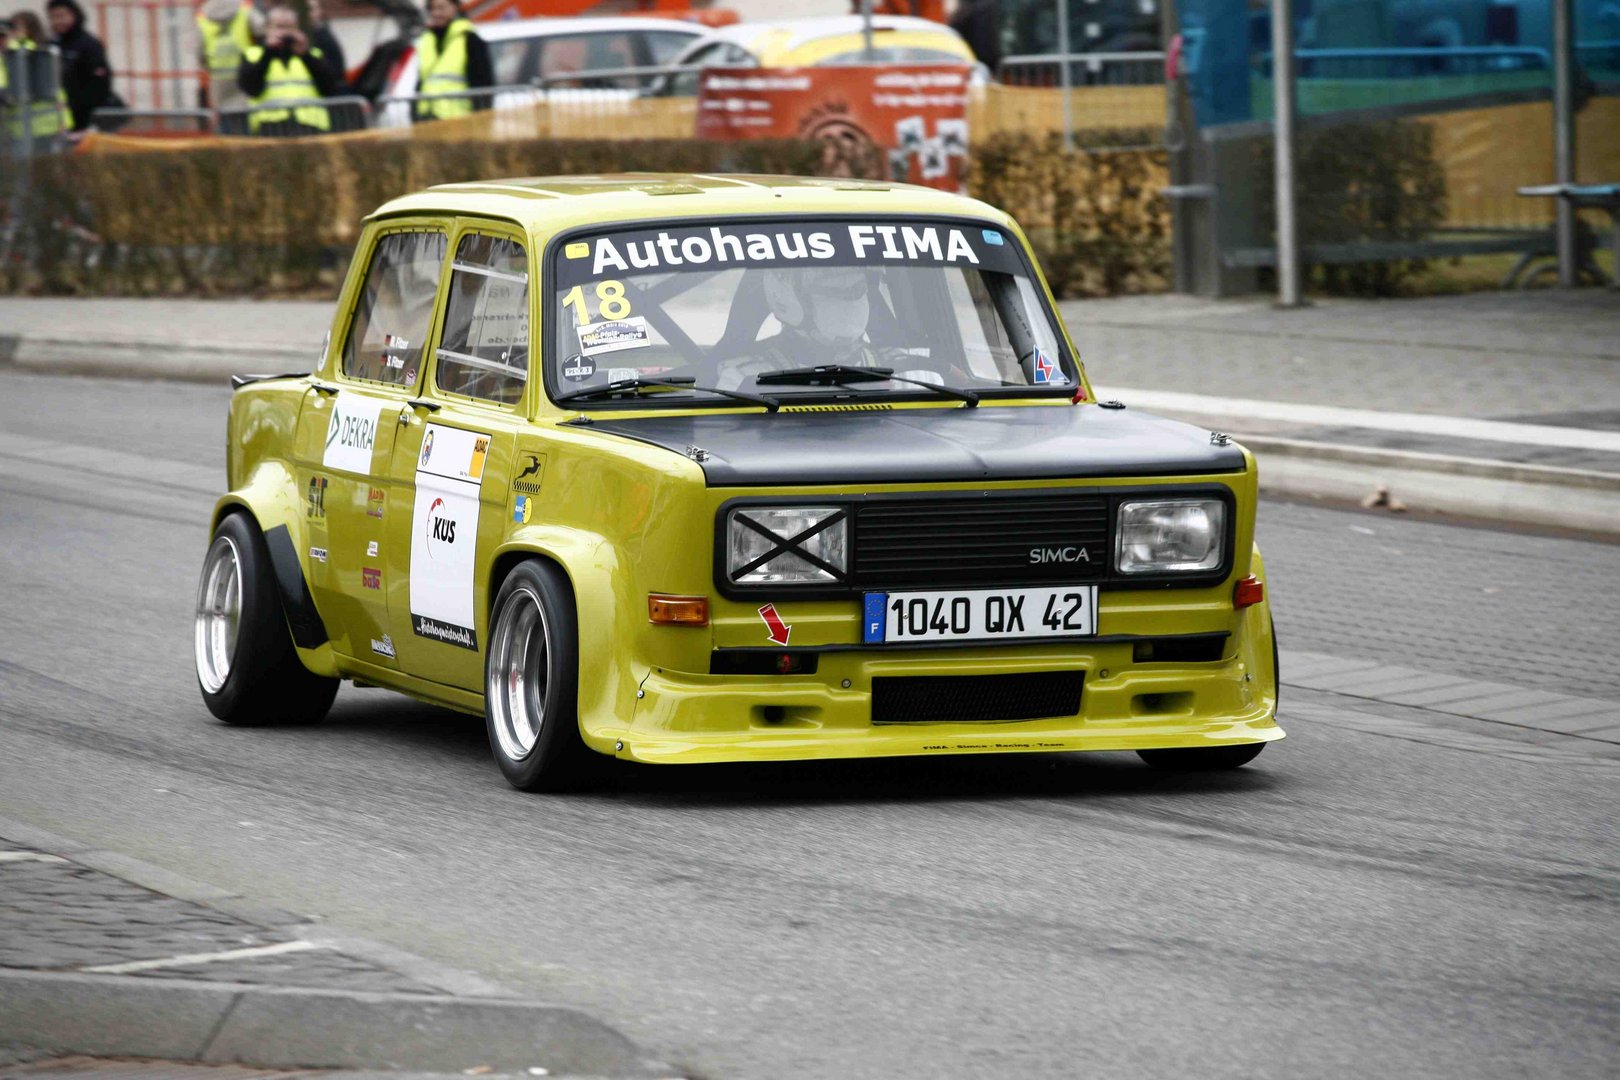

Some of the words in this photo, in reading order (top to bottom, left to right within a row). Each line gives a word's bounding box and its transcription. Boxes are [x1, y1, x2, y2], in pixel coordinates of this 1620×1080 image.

[592, 227, 836, 274] Autohaus
[847, 225, 979, 265] FIMA
[562, 280, 632, 326] 18
[341, 415, 374, 451] DEKRA
[1029, 547, 1090, 565] SIMCA
[870, 623, 879, 635] F
[891, 598, 970, 635] 1040
[985, 595, 1025, 632] QX
[1042, 593, 1082, 630] 42
